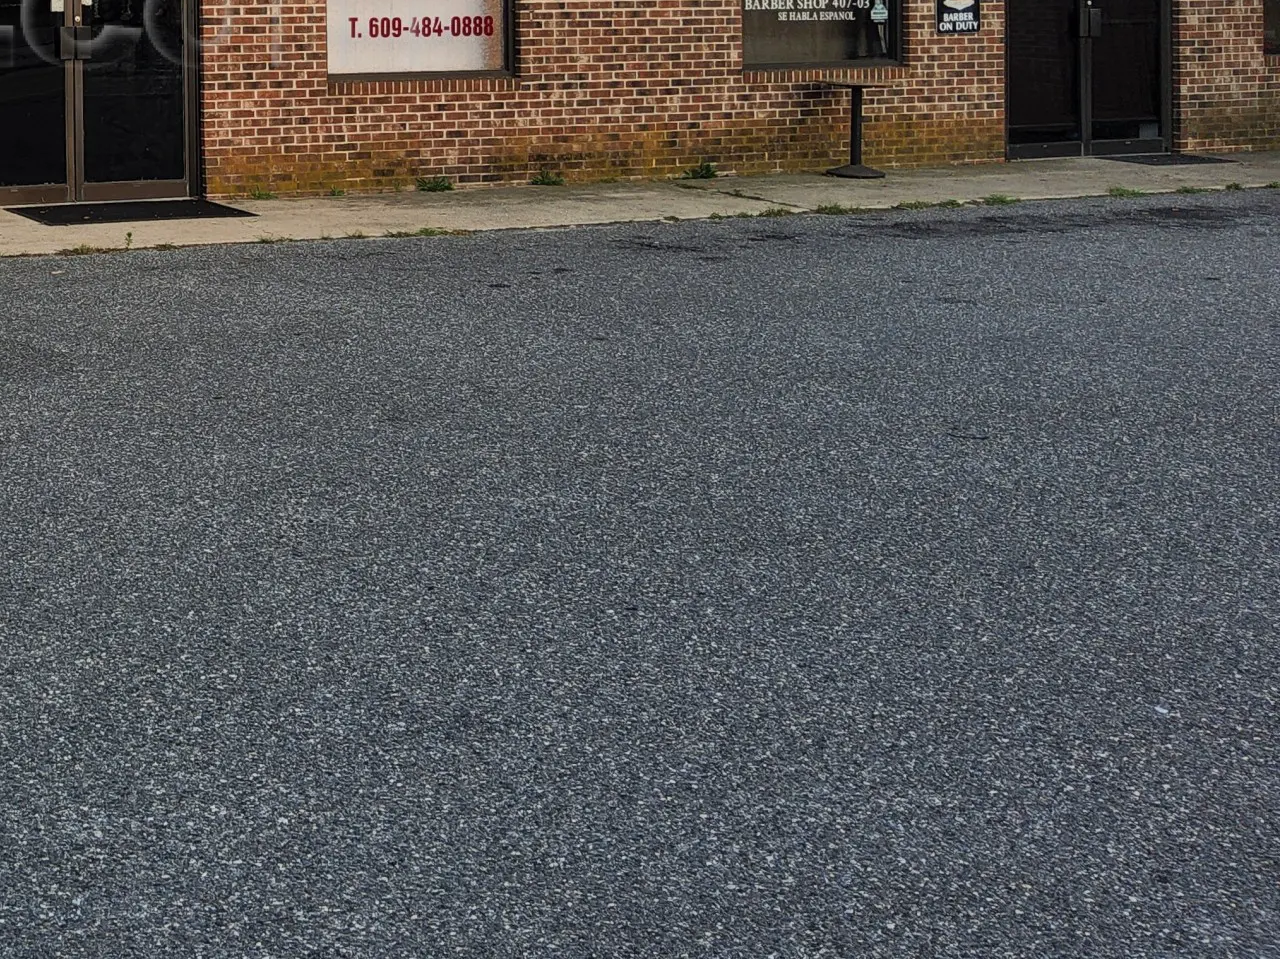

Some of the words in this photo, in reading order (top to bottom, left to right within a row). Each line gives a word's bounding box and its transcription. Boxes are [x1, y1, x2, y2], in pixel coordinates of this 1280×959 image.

[778, 12, 788, 21] SE
[789, 12, 819, 21] HABLA
[820, 12, 856, 21] ESPANOL
[943, 12, 973, 21] BARBER
[348, 17, 362, 38] T.
[369, 15, 494, 38] 609-484-0888
[940, 22, 953, 31] ON
[956, 21, 978, 30] DUTY
